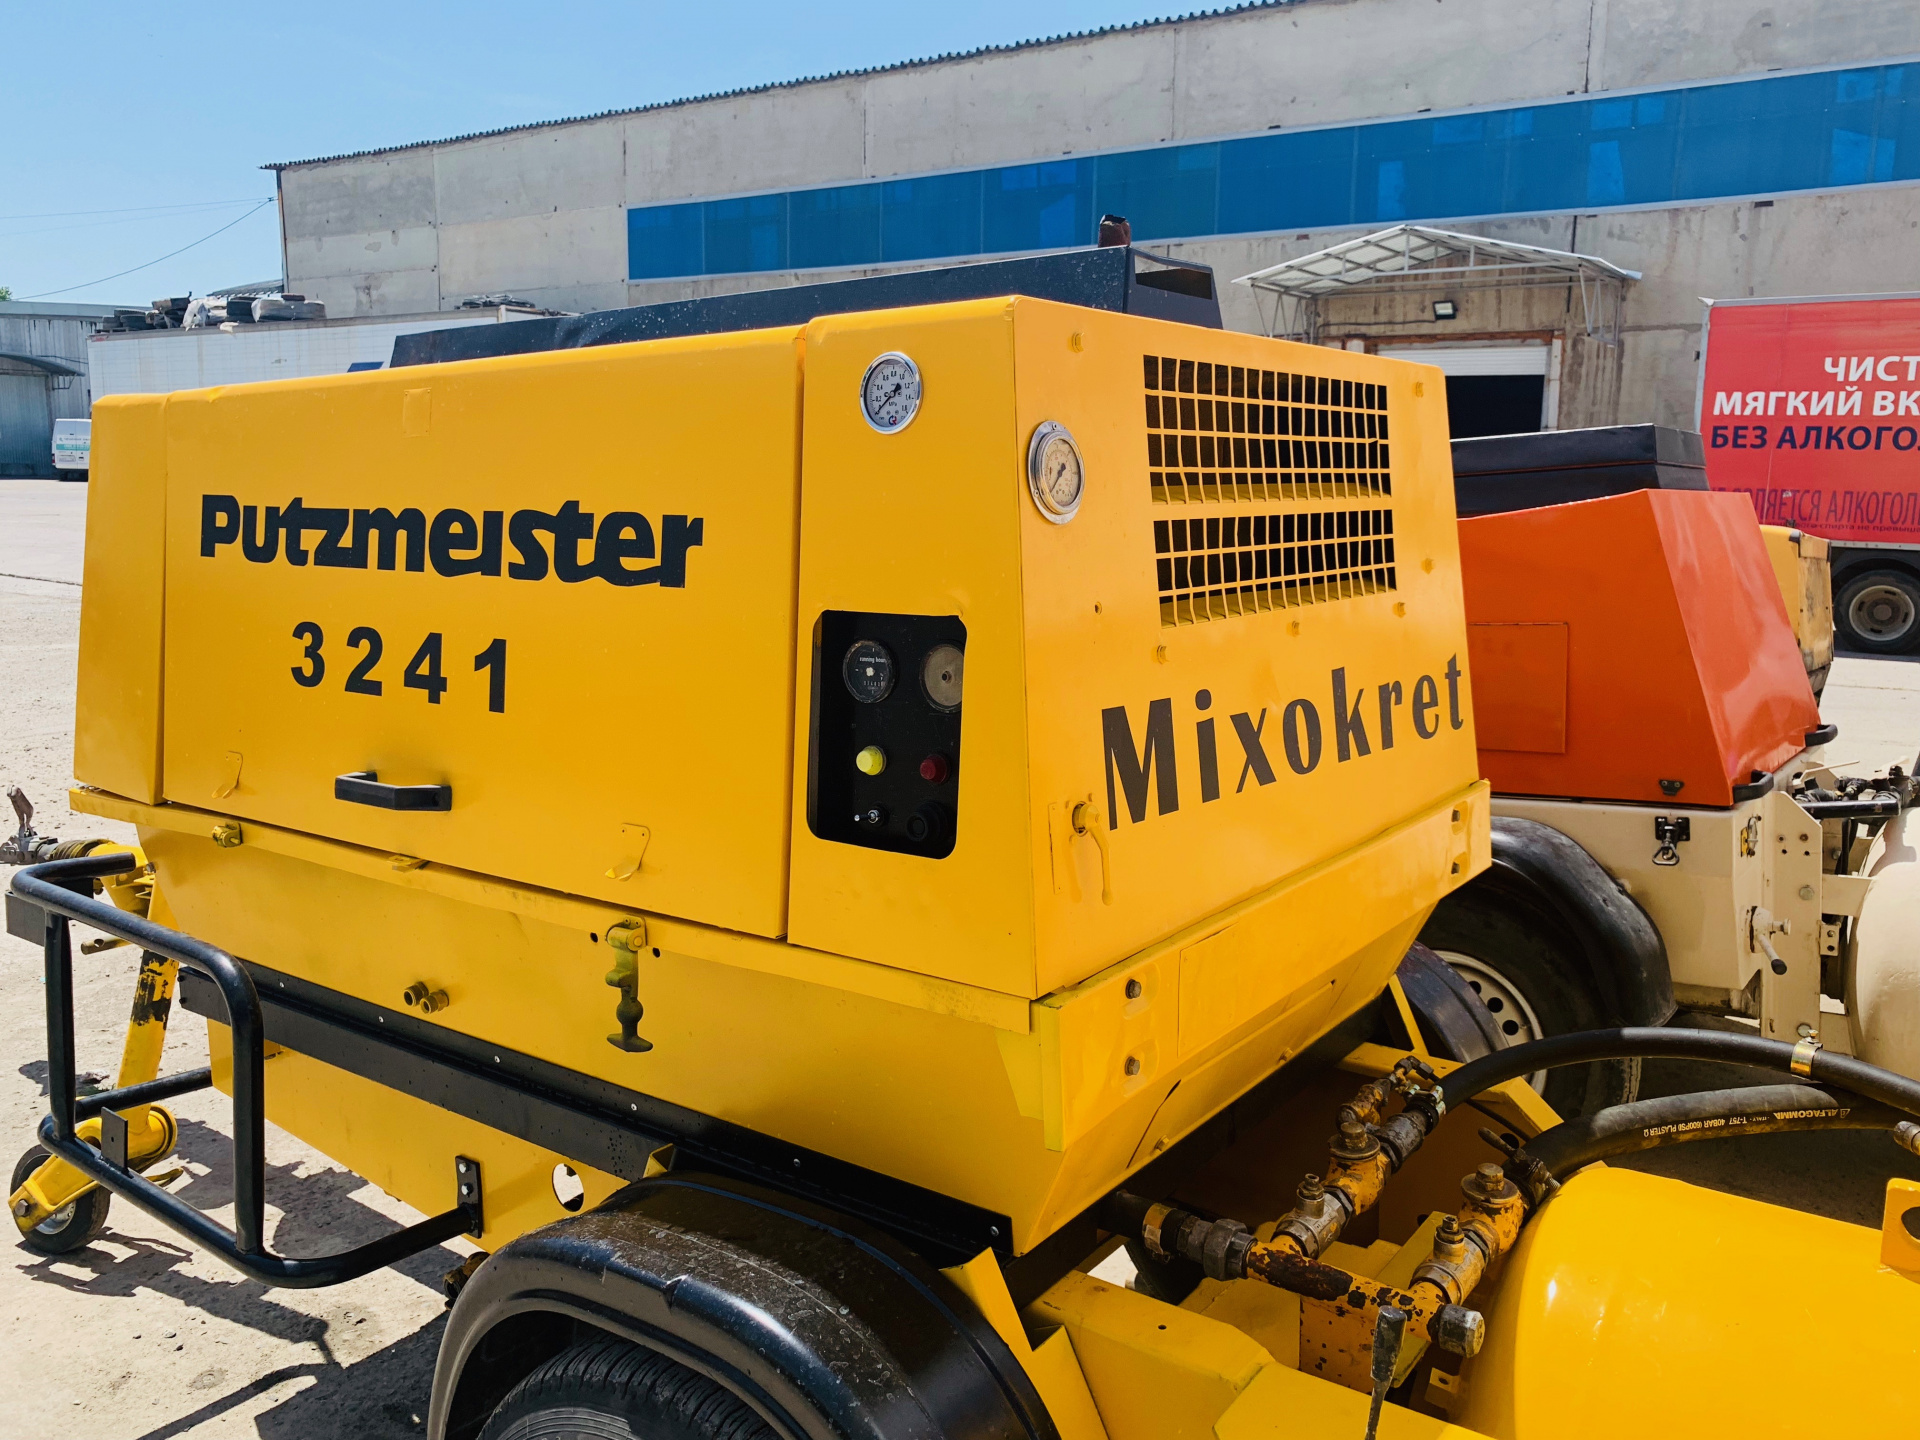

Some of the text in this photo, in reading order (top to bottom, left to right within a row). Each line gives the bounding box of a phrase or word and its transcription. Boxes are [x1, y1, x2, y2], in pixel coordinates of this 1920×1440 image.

[1824, 355, 1920, 382] ЧИСТ
[1713, 385, 1920, 416] МЯГКИЙ ВК
[1711, 425, 1920, 451] БЕЗ АЛКОГО
[1733, 487, 1920, 526] ЛЯЕТСЯ АЛКОГОЛ
[201, 494, 704, 588] Putzmeister
[1101, 652, 1464, 831] Mixokret
[1704, 1118, 1726, 1128] 40BAR
[1773, 1108, 1839, 1120] ALFAGOMMA
[1650, 1124, 1677, 1136] PLASTER
